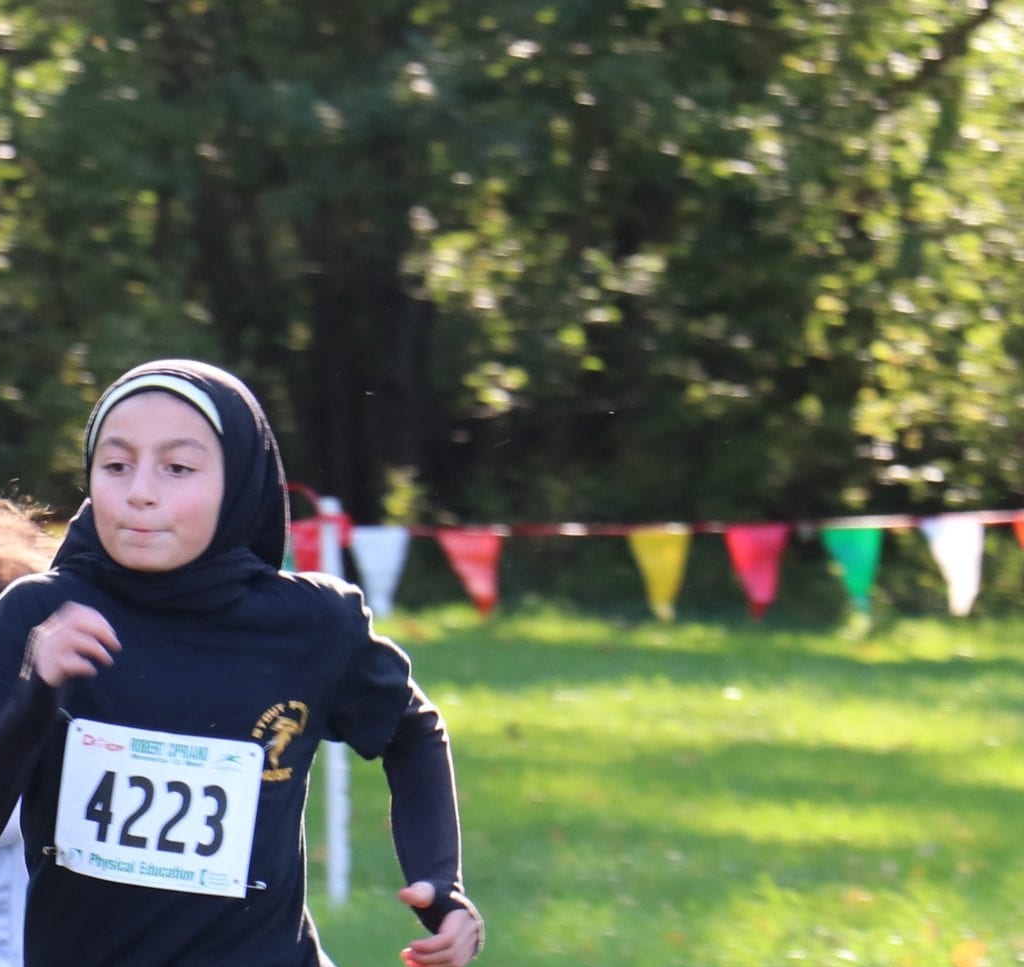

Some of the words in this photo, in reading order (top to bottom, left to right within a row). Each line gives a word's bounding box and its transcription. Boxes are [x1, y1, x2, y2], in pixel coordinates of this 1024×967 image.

[85, 770, 227, 857] 4223
[88, 852, 135, 874] Physical
[139, 861, 195, 882] Education
